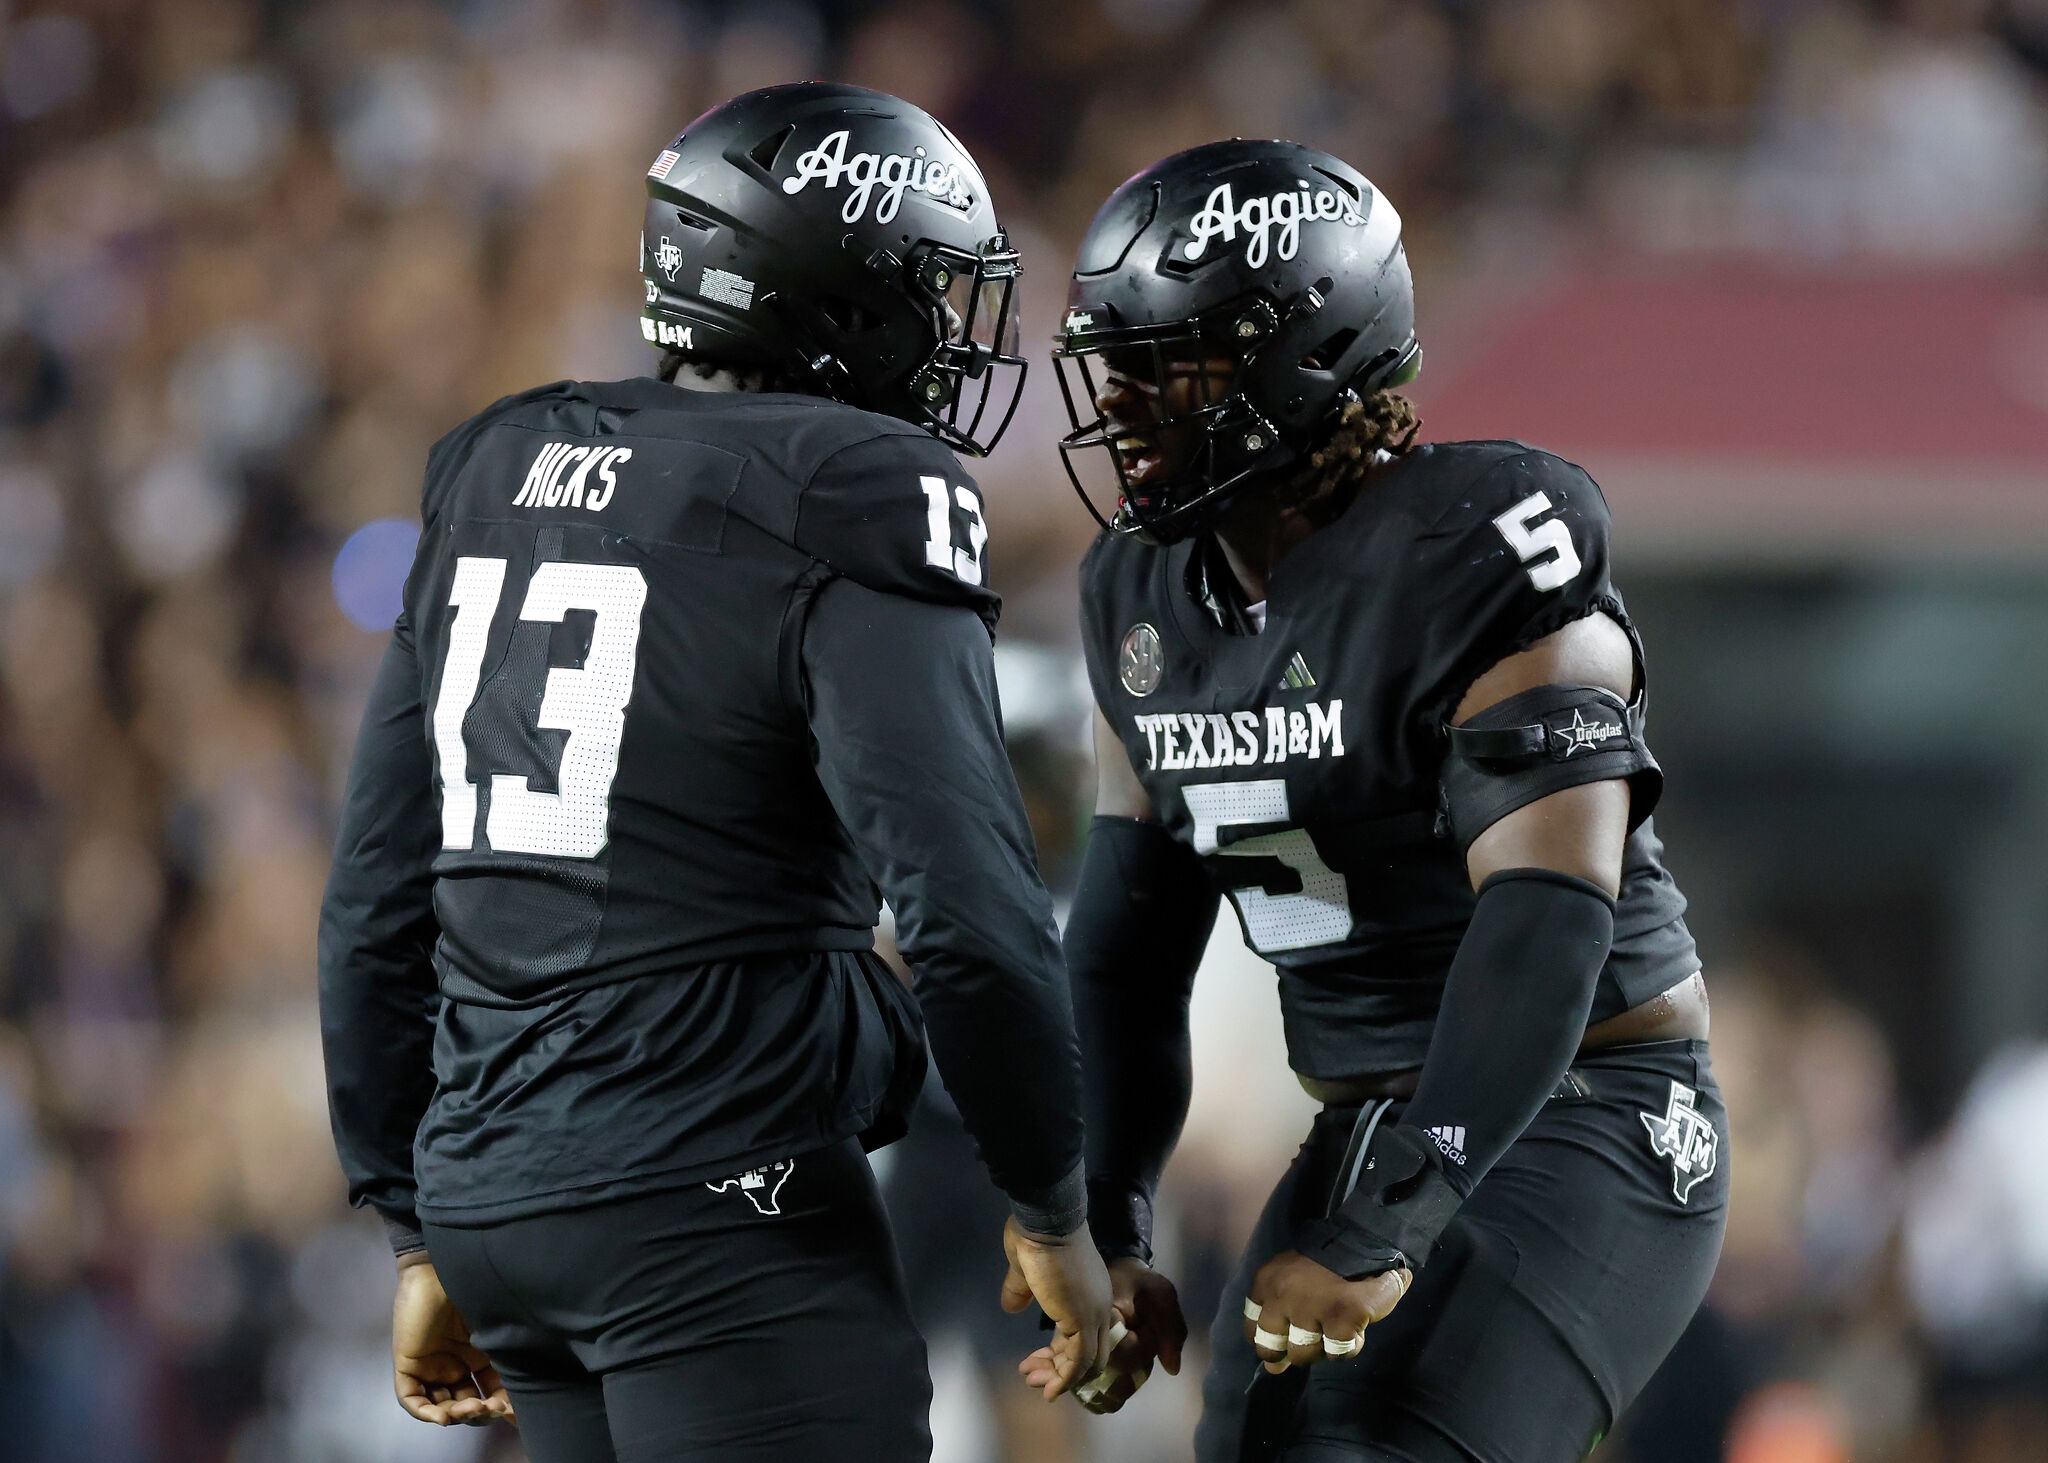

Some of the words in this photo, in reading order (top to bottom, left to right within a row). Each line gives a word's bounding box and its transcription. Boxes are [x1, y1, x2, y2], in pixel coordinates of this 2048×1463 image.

[782, 130, 973, 225] Aggies
[1184, 178, 1368, 270] Aggies
[511, 442, 633, 512] HICKS
[919, 475, 989, 587] 13
[1493, 490, 1582, 592] 5
[433, 556, 649, 858] 13
[1134, 711, 1260, 771] TEXAS
[1262, 699, 1346, 764] A&M
[1182, 778, 1353, 953] 5
